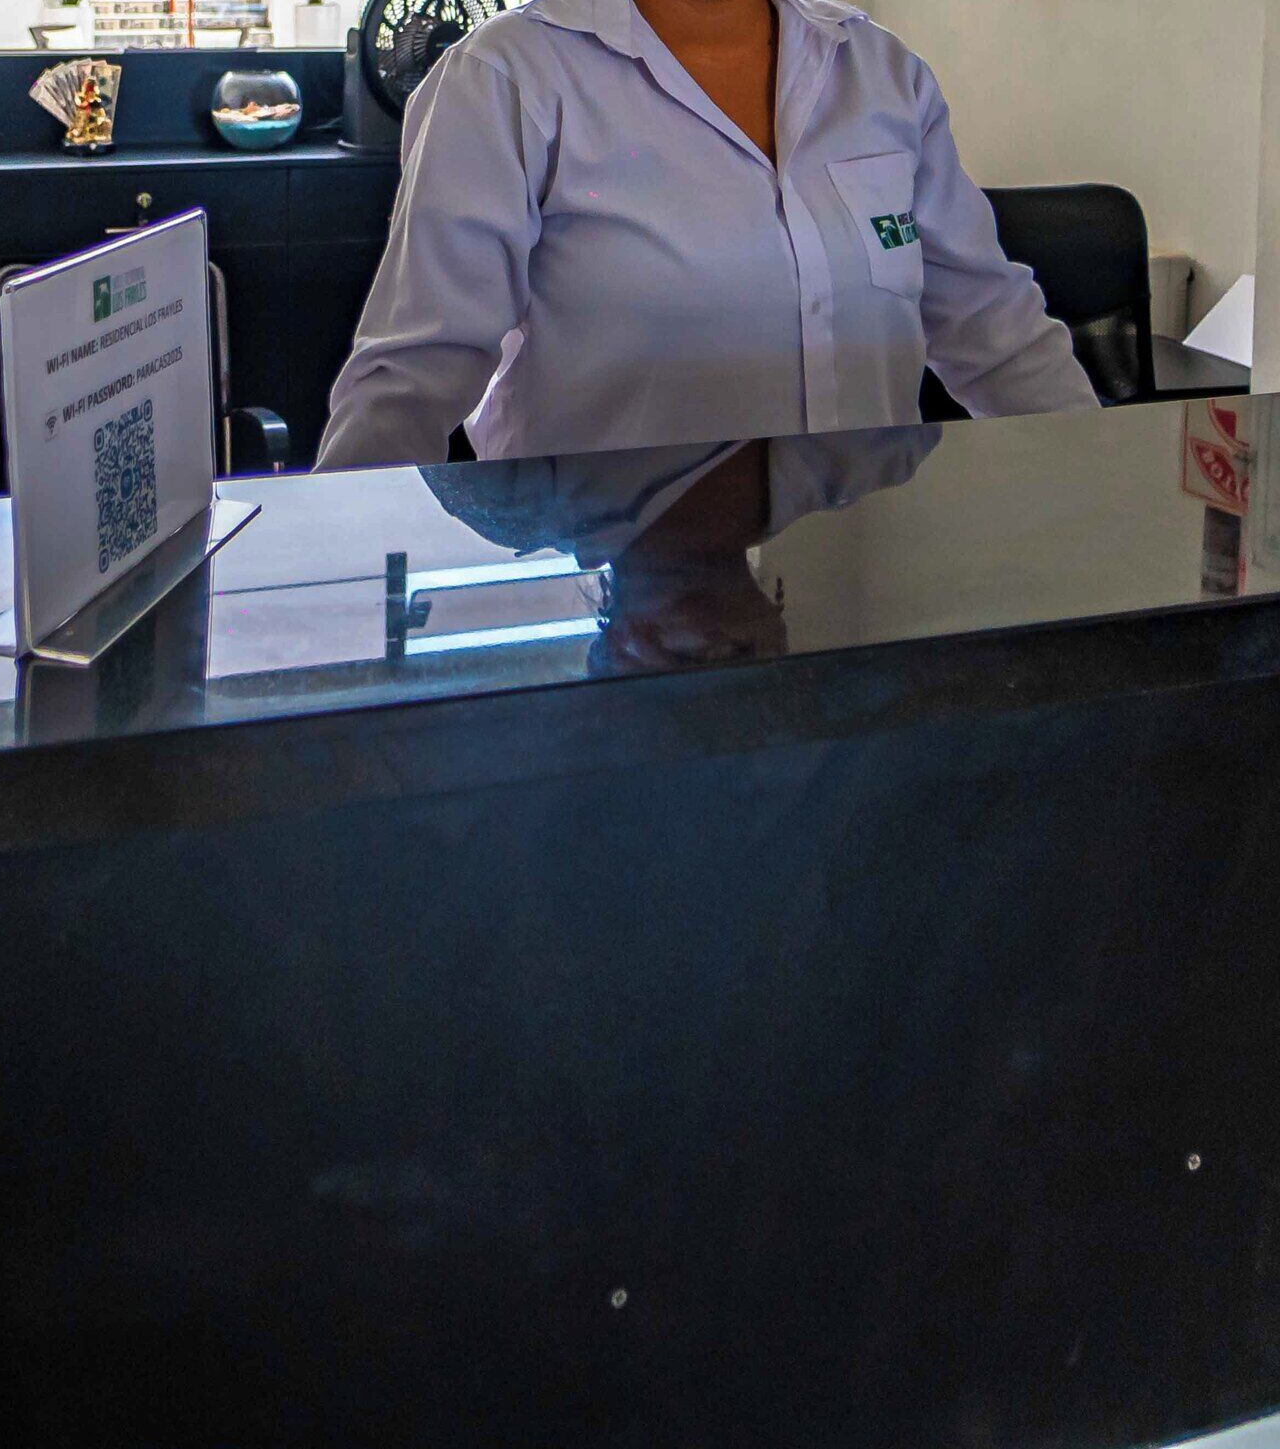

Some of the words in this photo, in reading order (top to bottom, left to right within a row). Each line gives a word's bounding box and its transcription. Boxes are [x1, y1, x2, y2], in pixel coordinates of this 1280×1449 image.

[46, 352, 69, 374] WI-FI
[71, 339, 99, 363] NAME:
[100, 319, 144, 349] RESIDENCIAL
[145, 311, 157, 329] LOS
[158, 299, 183, 322] FRAYLES
[62, 398, 86, 423] WI-FI
[87, 374, 136, 410] PASSWORD:
[136, 346, 183, 381] PARACAS2025
